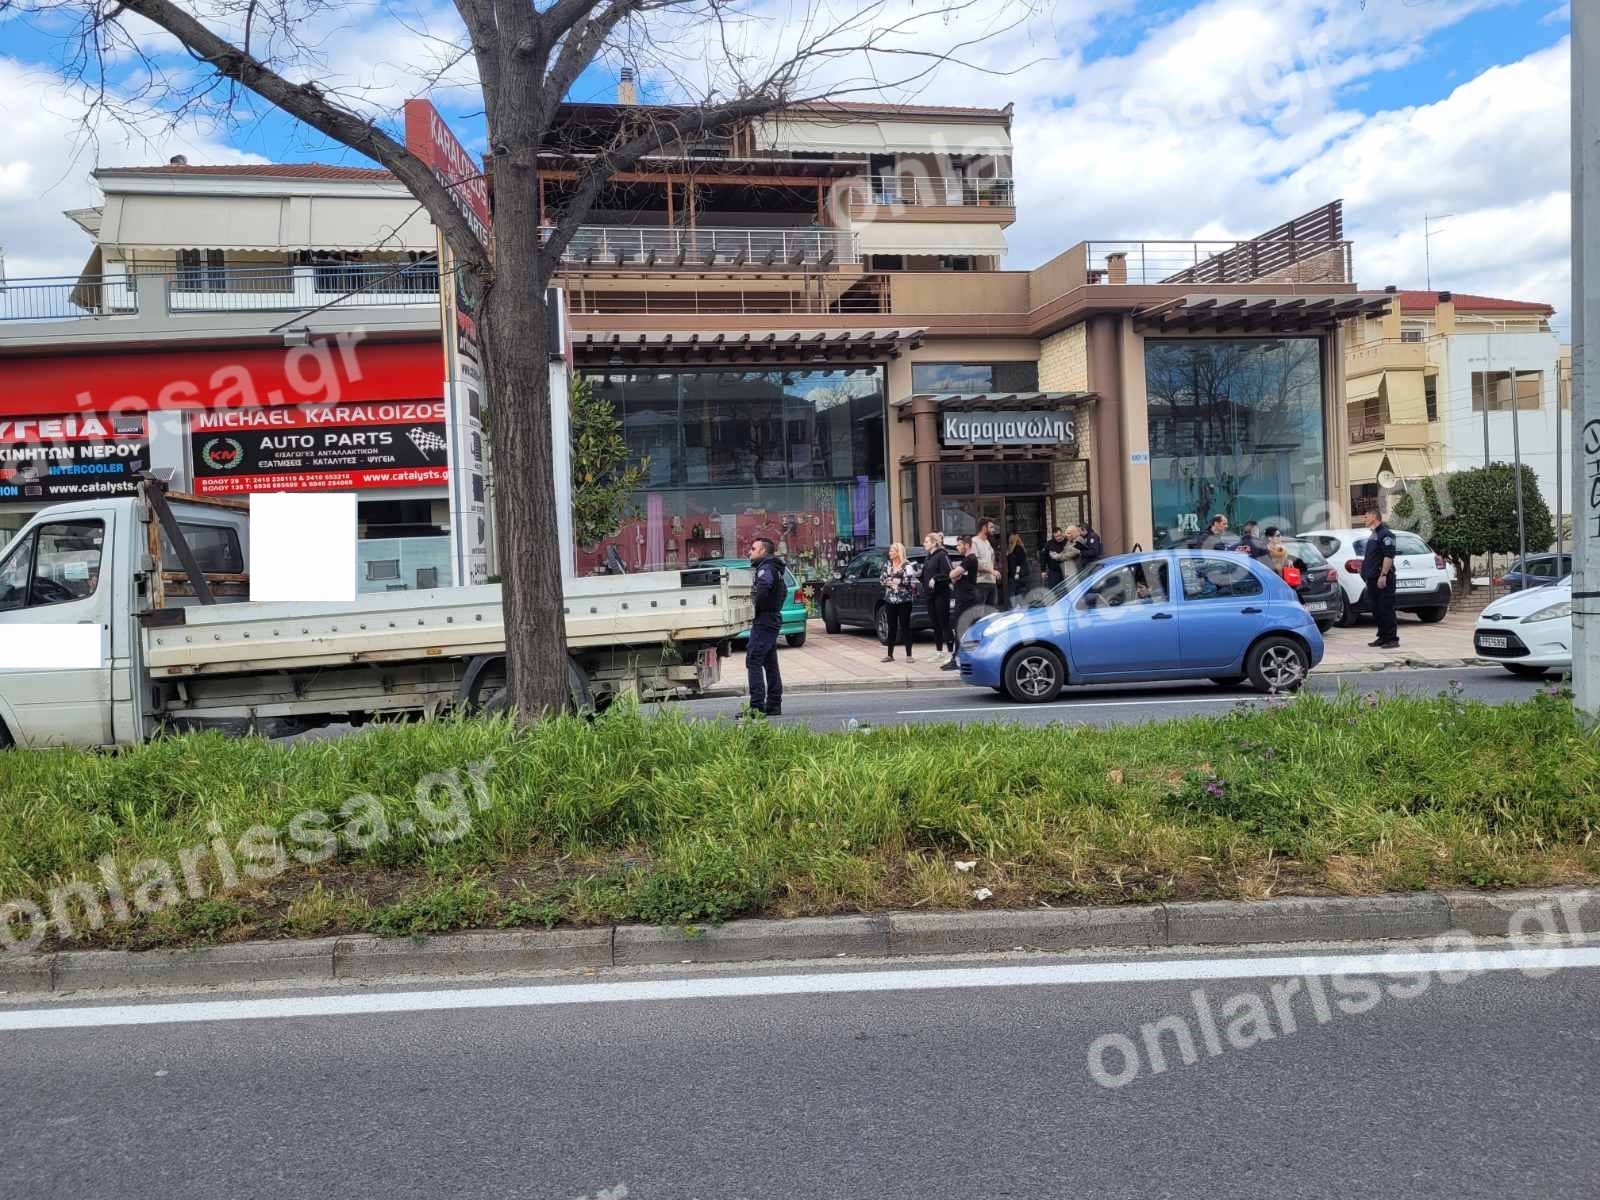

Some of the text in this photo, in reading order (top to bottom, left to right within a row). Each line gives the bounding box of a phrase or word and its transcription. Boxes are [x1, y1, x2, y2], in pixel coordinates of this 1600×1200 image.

[462, 203, 488, 246] PARTS
[200, 403, 446, 428] MICHAEL KARALOIZOS
[259, 431, 393, 450] AUTO PARTS
[945, 416, 1075, 443] Καραμανώλης
[81, 444, 141, 458] ΝΕΡΟΥ
[48, 463, 124, 475] INTERCOOLER
